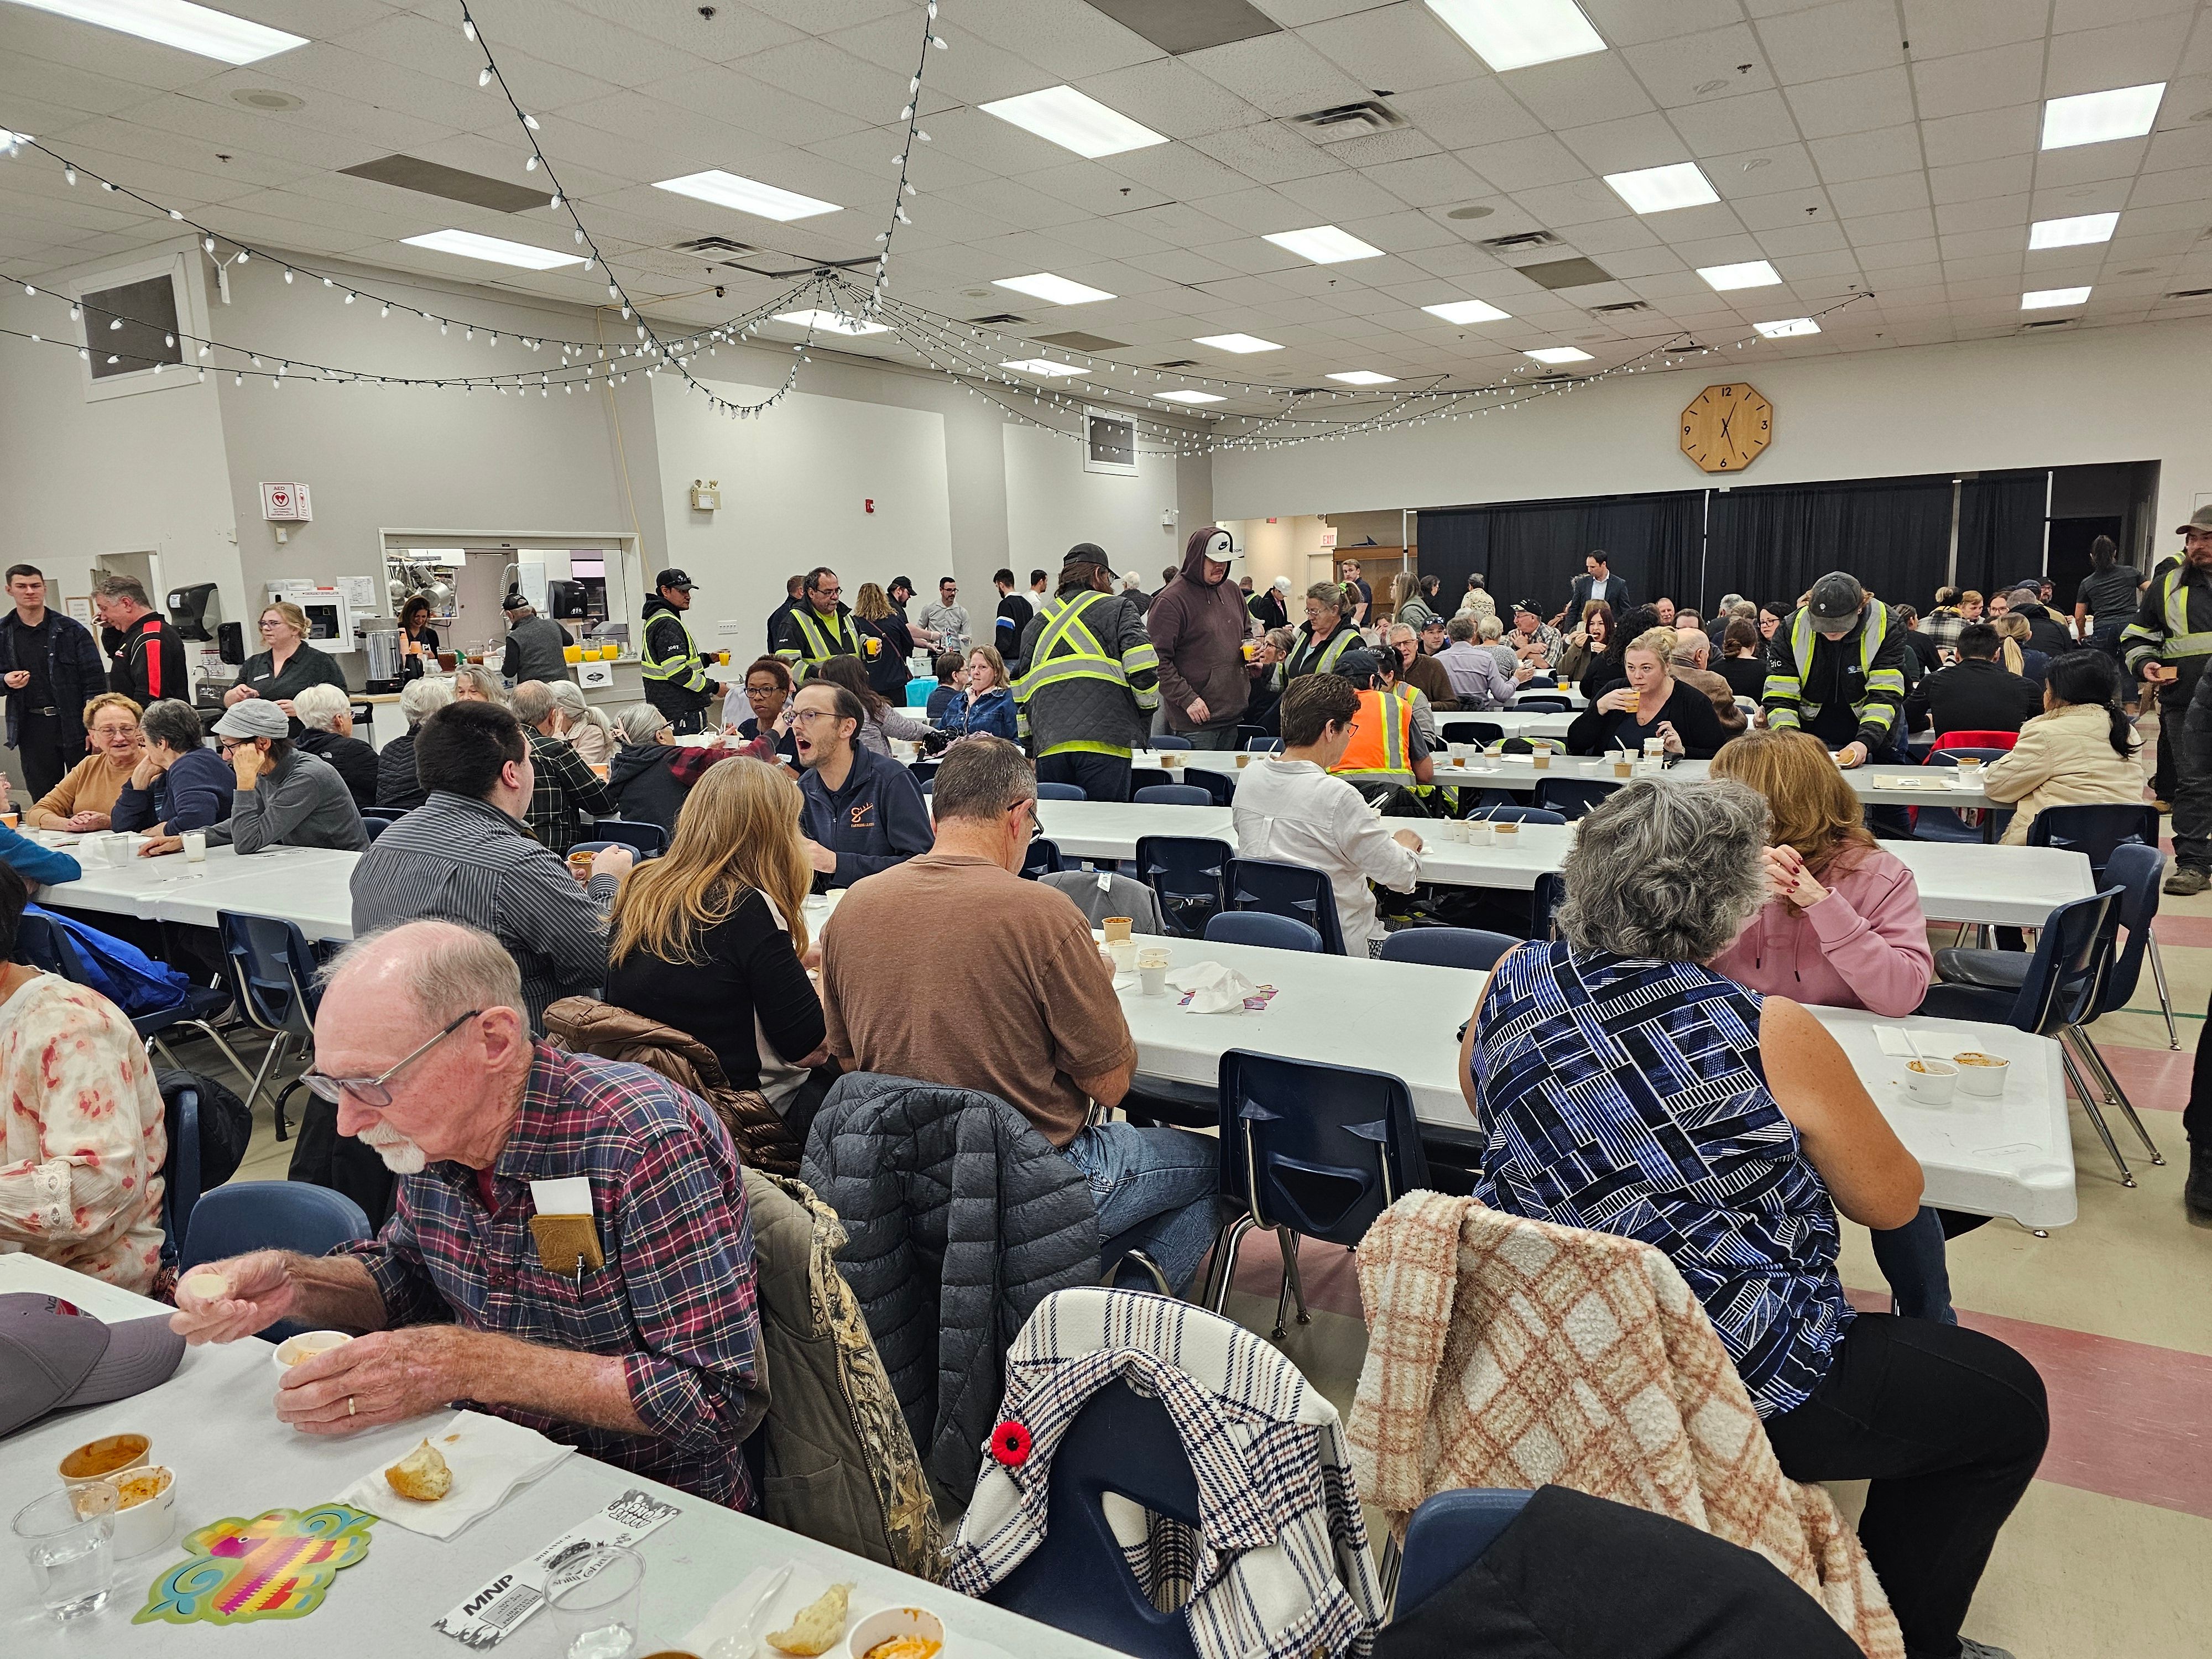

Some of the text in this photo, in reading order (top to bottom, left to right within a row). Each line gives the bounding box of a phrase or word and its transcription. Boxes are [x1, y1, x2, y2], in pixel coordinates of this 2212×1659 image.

[1721, 387, 1731, 397] 12
[1761, 420, 1768, 430] 3
[1684, 425, 1691, 436] 9
[1720, 458, 1727, 468] 6
[1323, 535, 1334, 545] EXIT
[628, 1503, 656, 1520] ONE
[608, 1508, 652, 1529] ADMIT
[462, 1574, 513, 1616] MNP
